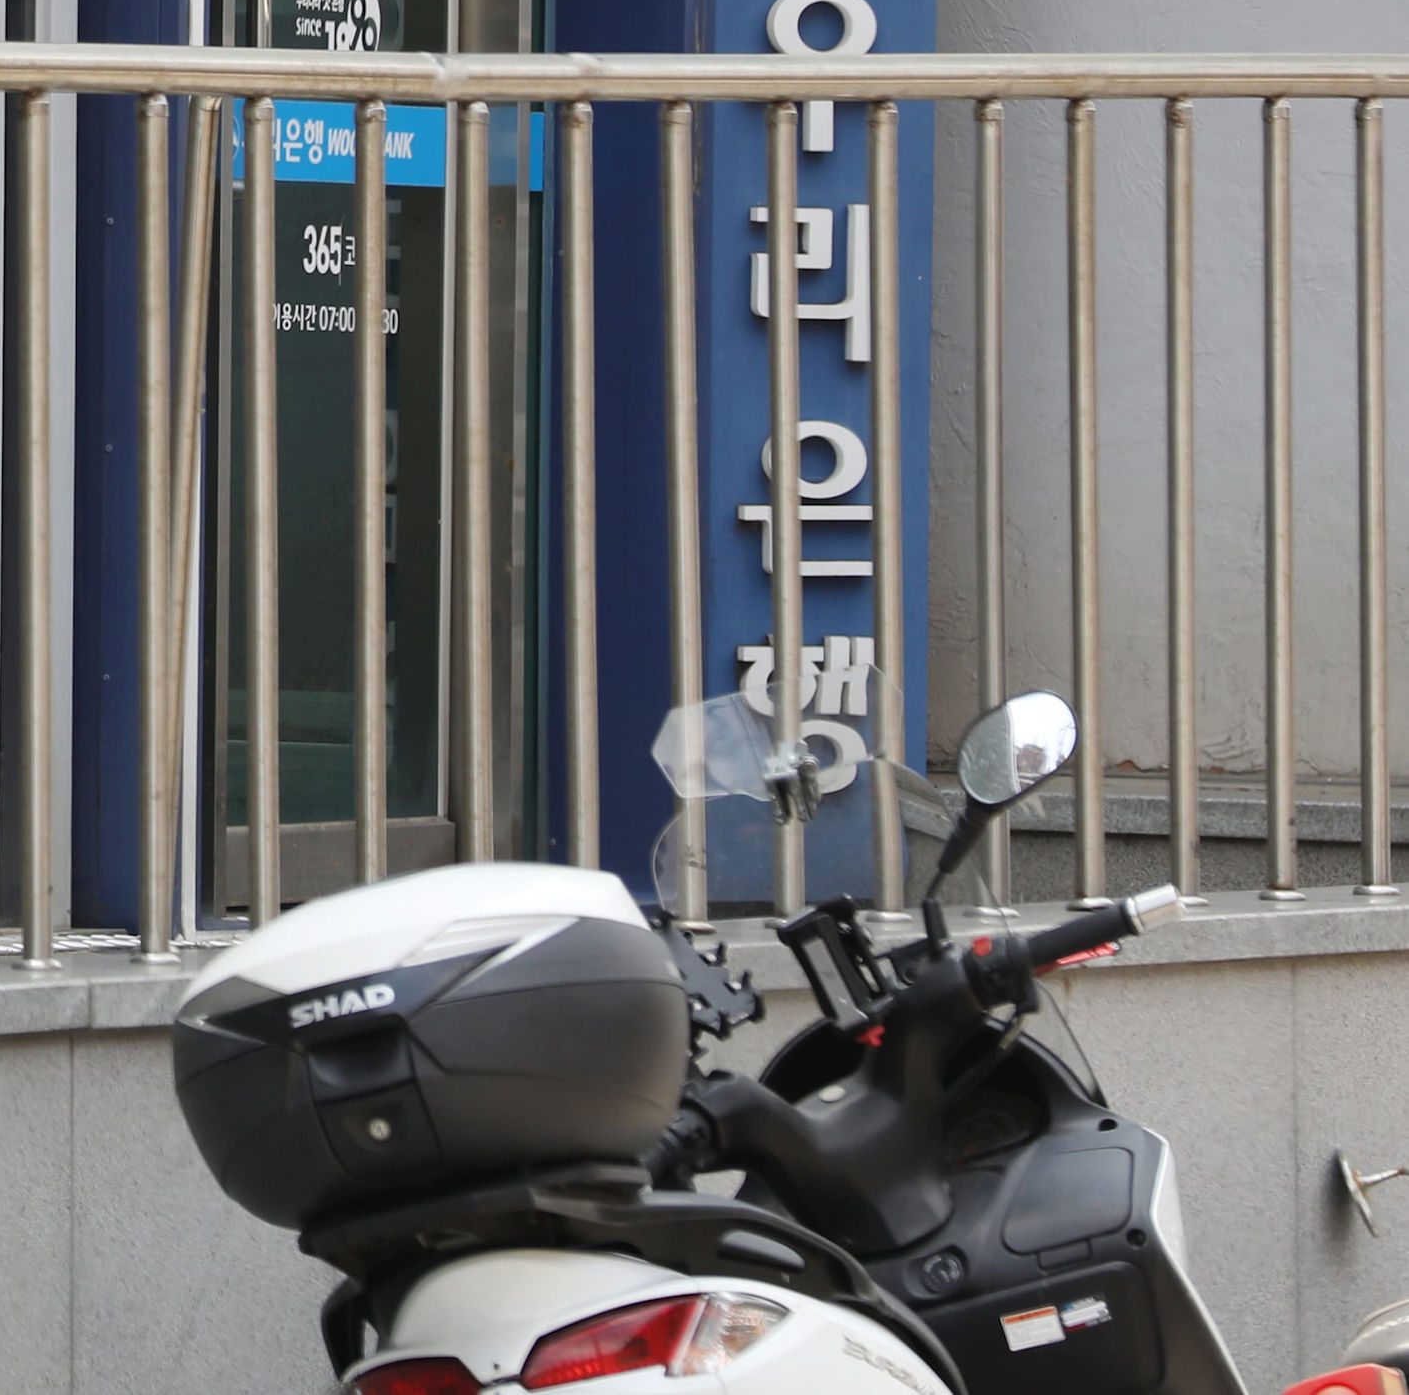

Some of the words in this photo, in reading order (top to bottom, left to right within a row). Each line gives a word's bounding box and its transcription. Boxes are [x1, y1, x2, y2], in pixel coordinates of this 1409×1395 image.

[383, 131, 415, 160] ANK
[302, 223, 356, 277] 365코
[288, 982, 396, 1029] SHAD
